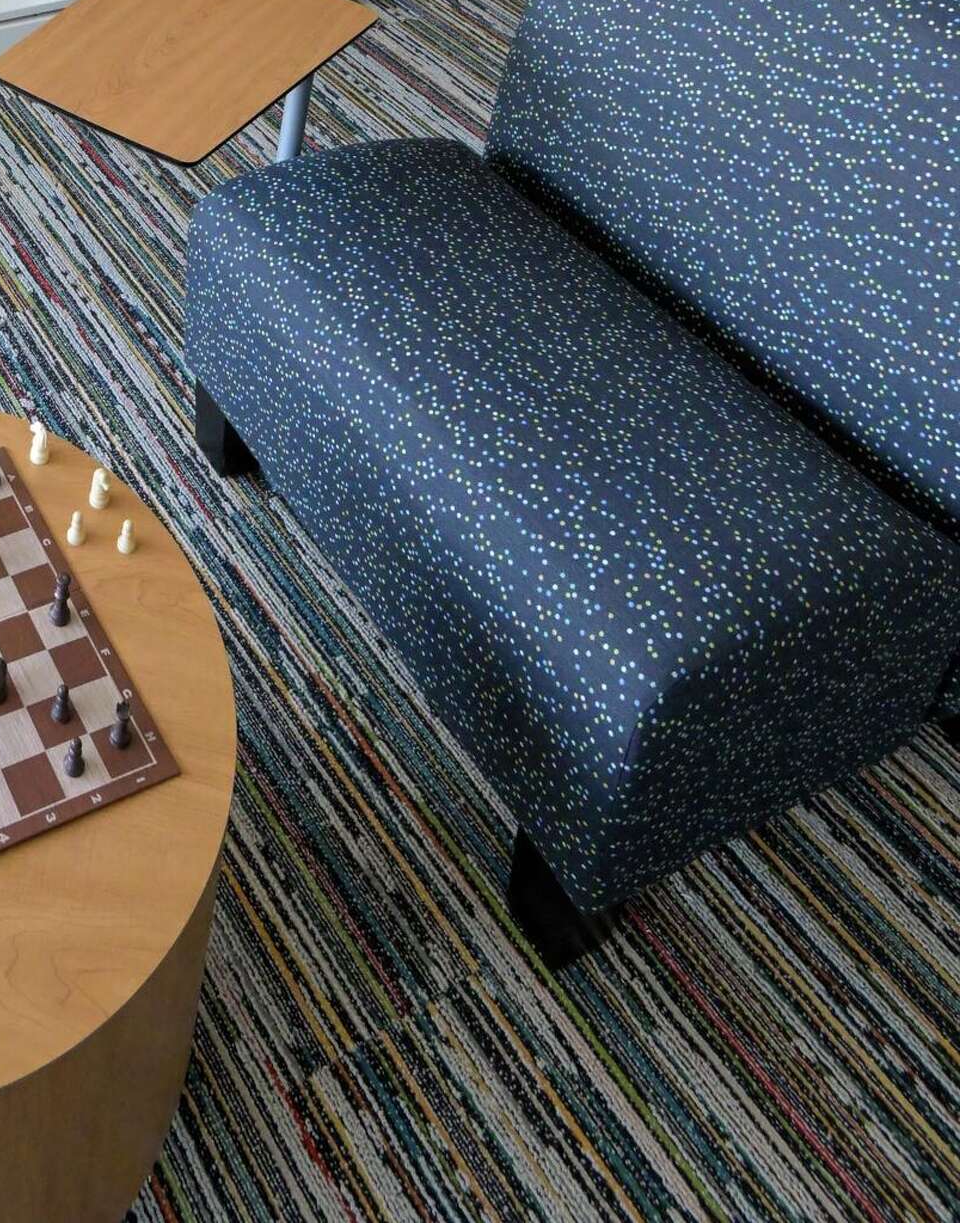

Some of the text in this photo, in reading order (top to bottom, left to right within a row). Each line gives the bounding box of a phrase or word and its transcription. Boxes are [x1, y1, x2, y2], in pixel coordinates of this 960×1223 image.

[42, 538, 51, 547] C
[100, 647, 111, 656] F
[144, 731, 157, 743] H
[0, 832, 10, 844] 4
[45, 812, 57, 823] 3
[90, 794, 103, 804] 2
